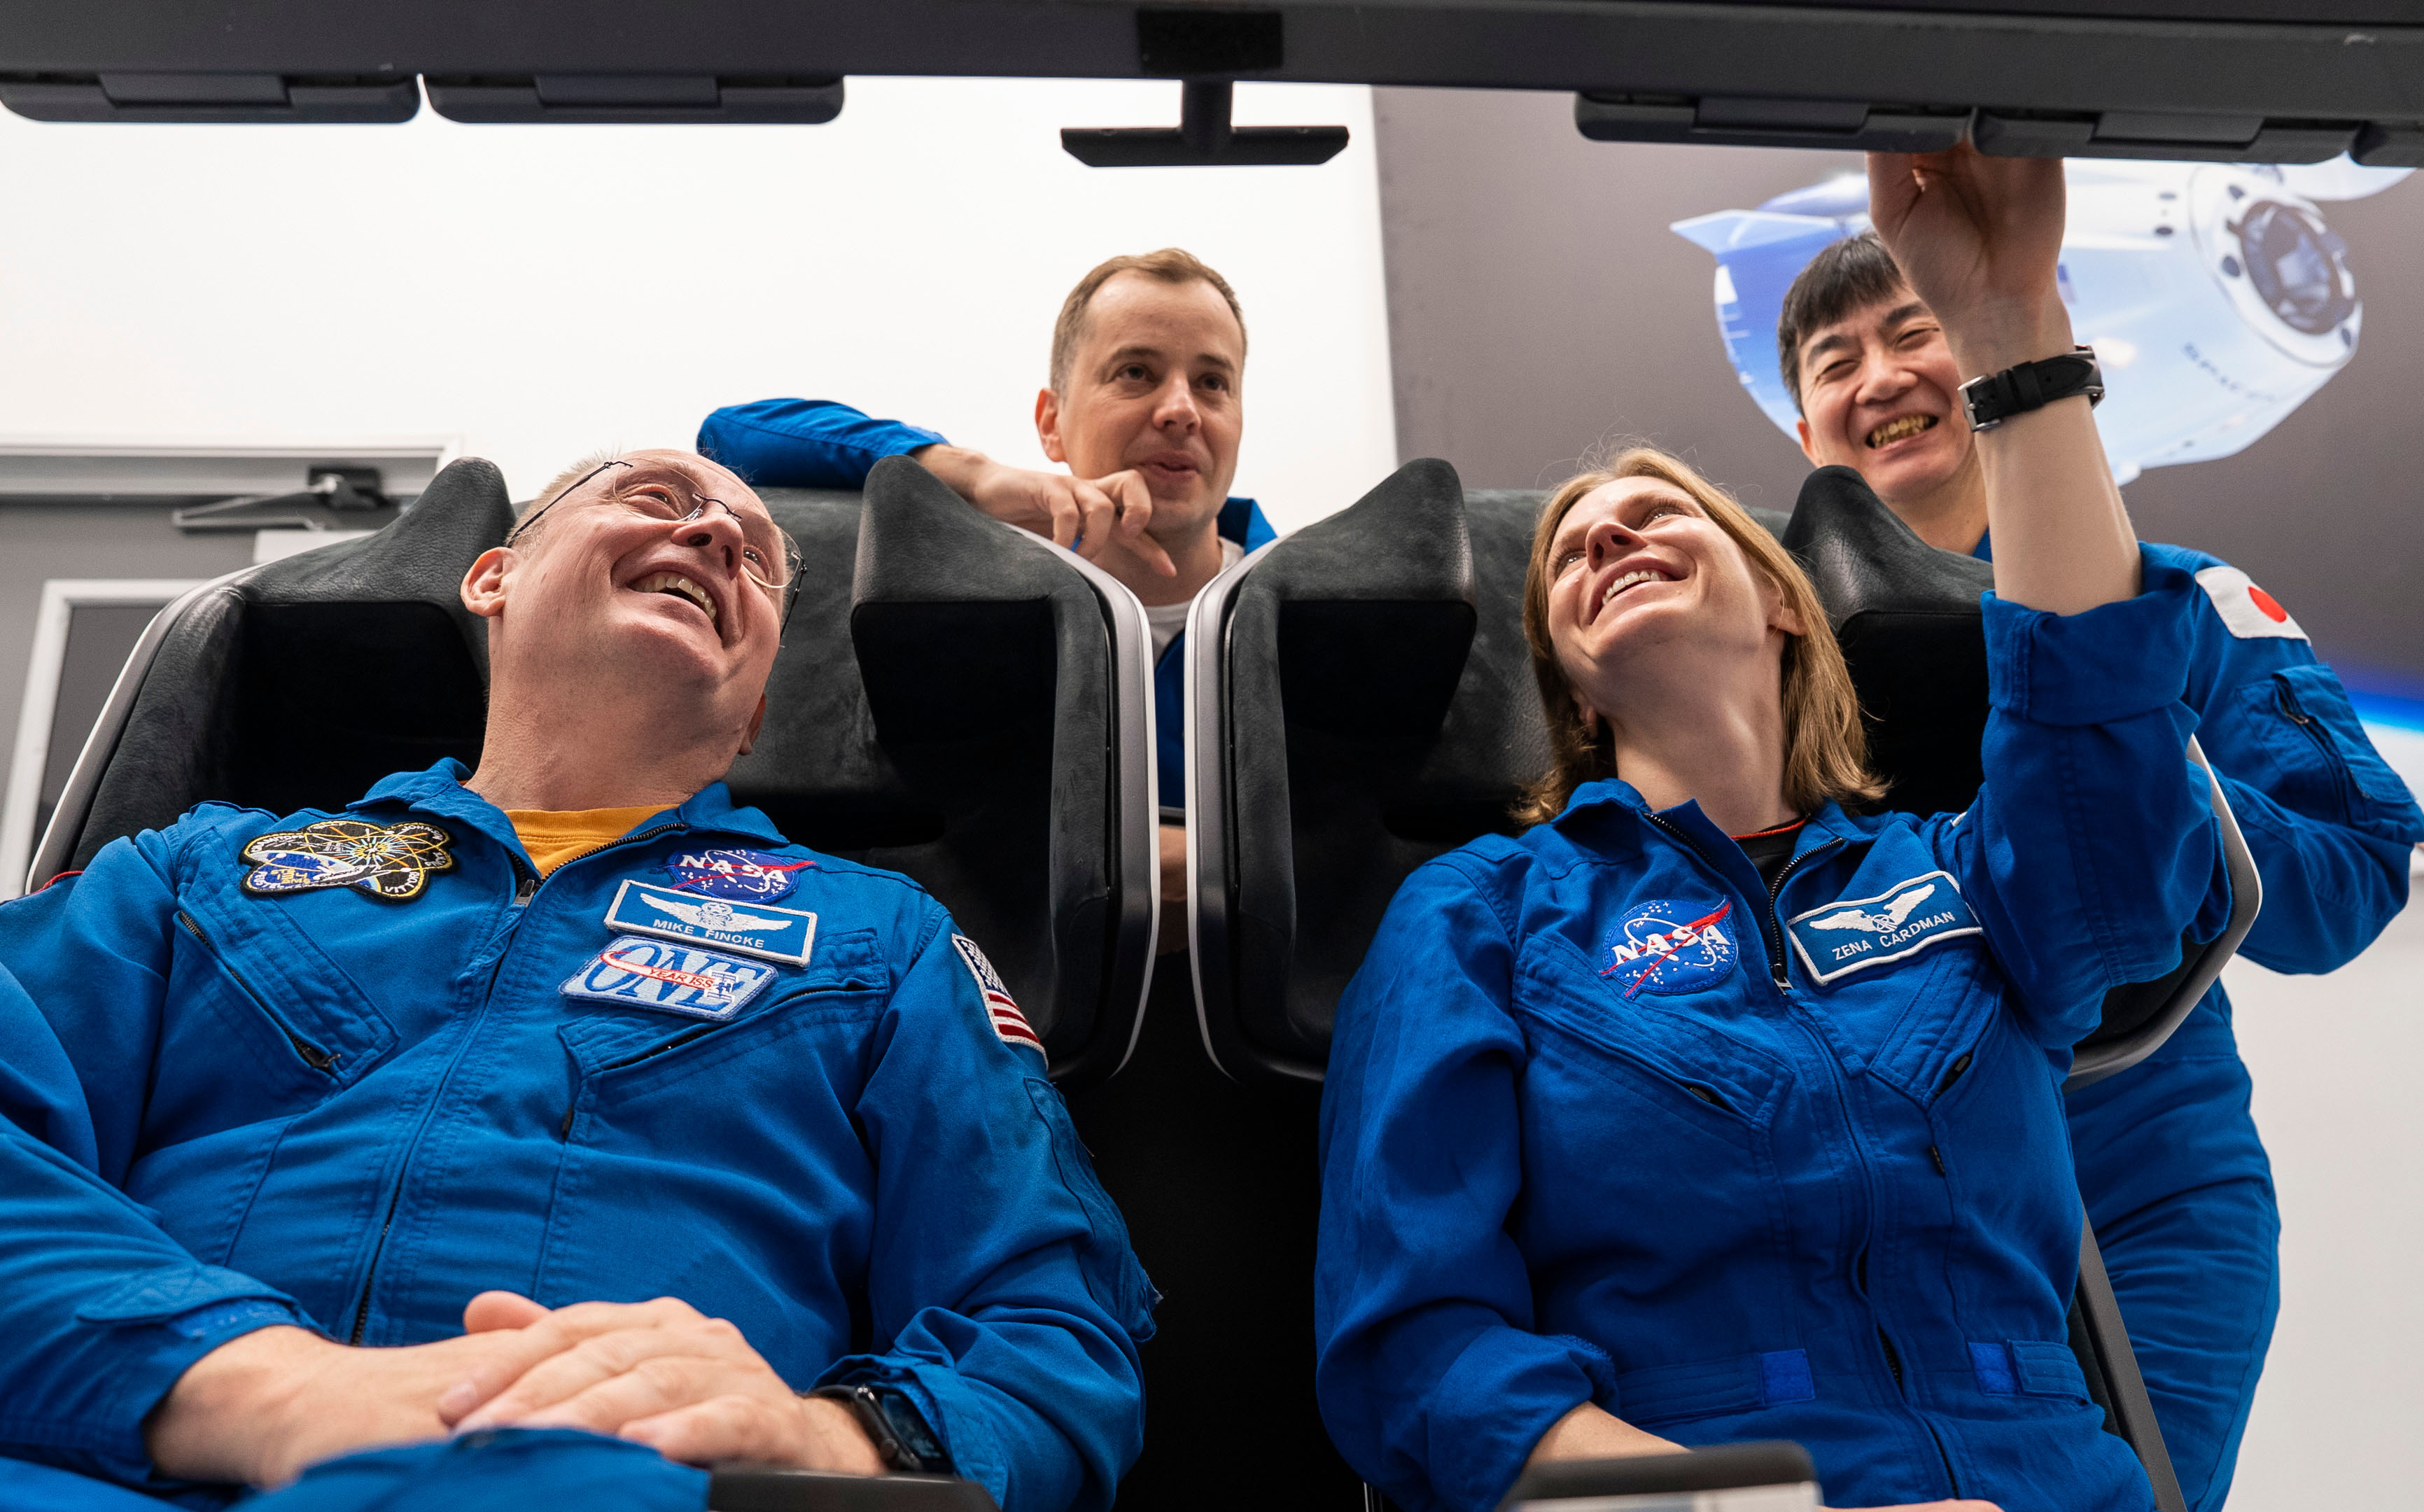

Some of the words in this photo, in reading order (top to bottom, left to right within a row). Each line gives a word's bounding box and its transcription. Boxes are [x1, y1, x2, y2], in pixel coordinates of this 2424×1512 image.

[679, 854, 789, 883] NASA
[654, 918, 695, 936] MIKE
[705, 928, 765, 948] FINCKE
[1610, 923, 1730, 965] NASA
[1832, 939, 1873, 961] ZENA
[1879, 910, 1956, 948] CARDMAN
[584, 943, 767, 1012] ONE
[650, 968, 689, 986] YEAR
[687, 976, 715, 989] ISS
